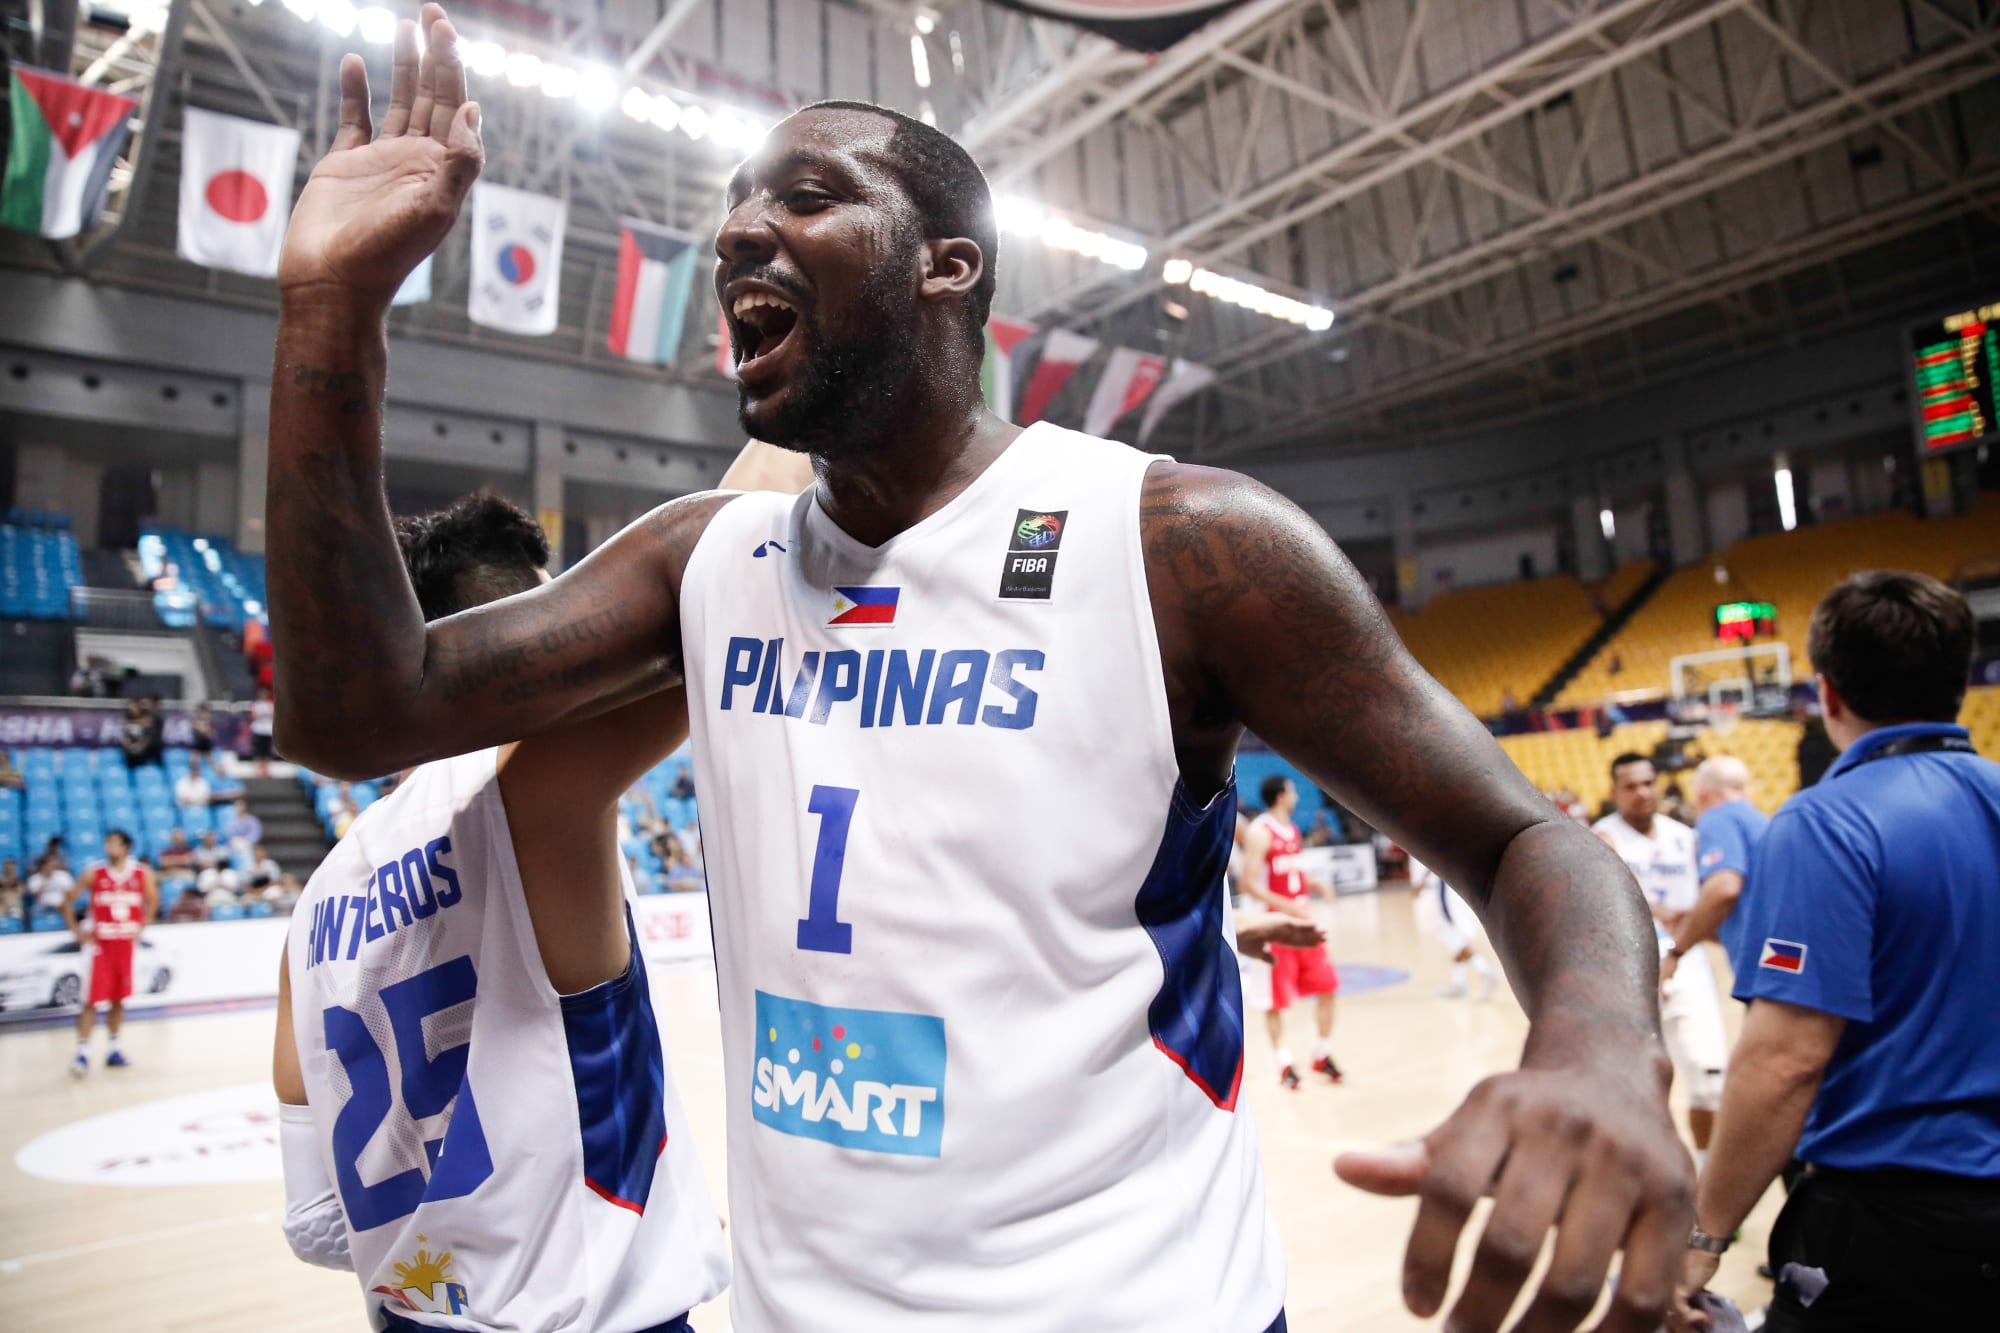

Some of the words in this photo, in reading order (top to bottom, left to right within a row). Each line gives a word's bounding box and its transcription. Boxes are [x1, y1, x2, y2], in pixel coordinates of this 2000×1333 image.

[1011, 558, 1048, 573] FIBA
[797, 785, 860, 954] 1
[323, 954, 493, 1232] 25
[753, 1056, 937, 1137] SMART
